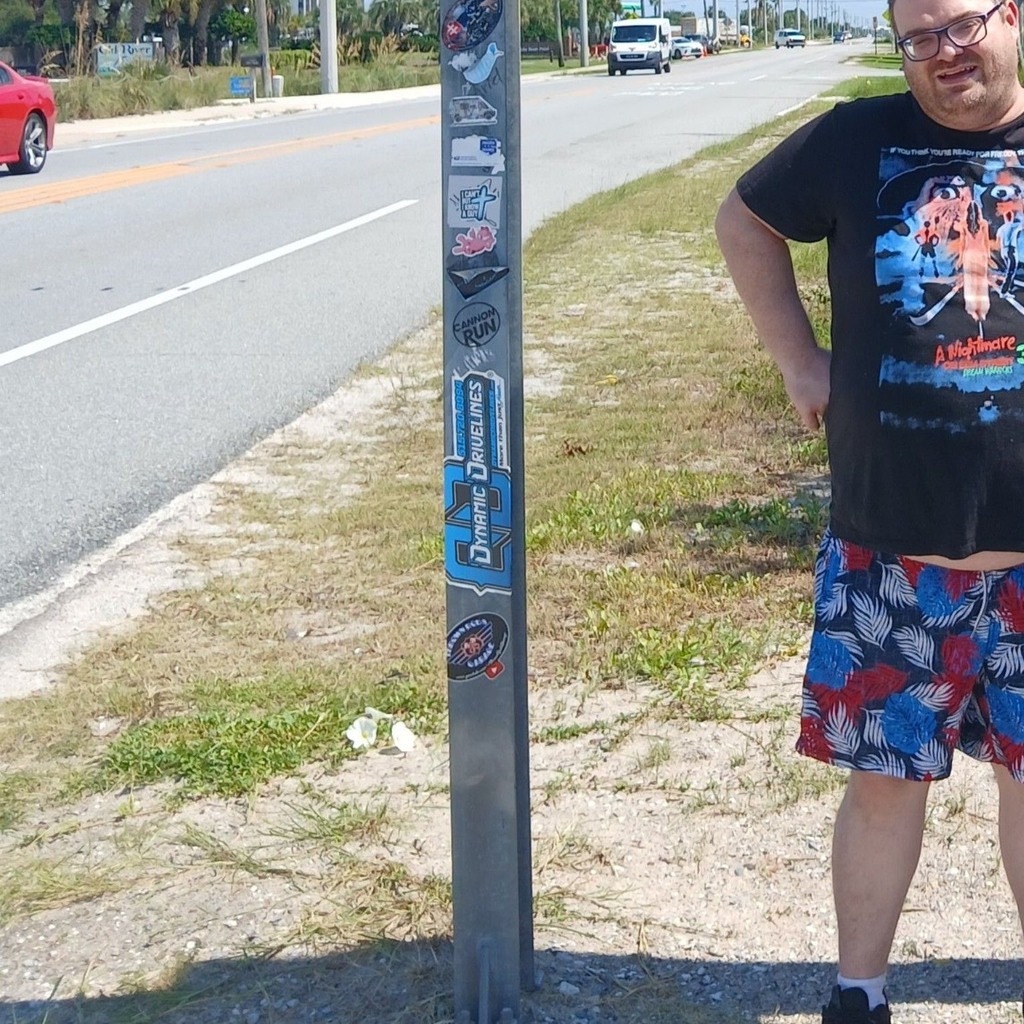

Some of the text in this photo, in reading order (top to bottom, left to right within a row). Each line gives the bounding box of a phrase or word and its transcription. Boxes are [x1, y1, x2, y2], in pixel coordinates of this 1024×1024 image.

[453, 308, 497, 333] CANNON
[463, 322, 497, 348] RUN
[947, 336, 1016, 361] Nightmare
[466, 379, 488, 481] DRIVELINES
[469, 484, 491, 566] DYNAMIC
